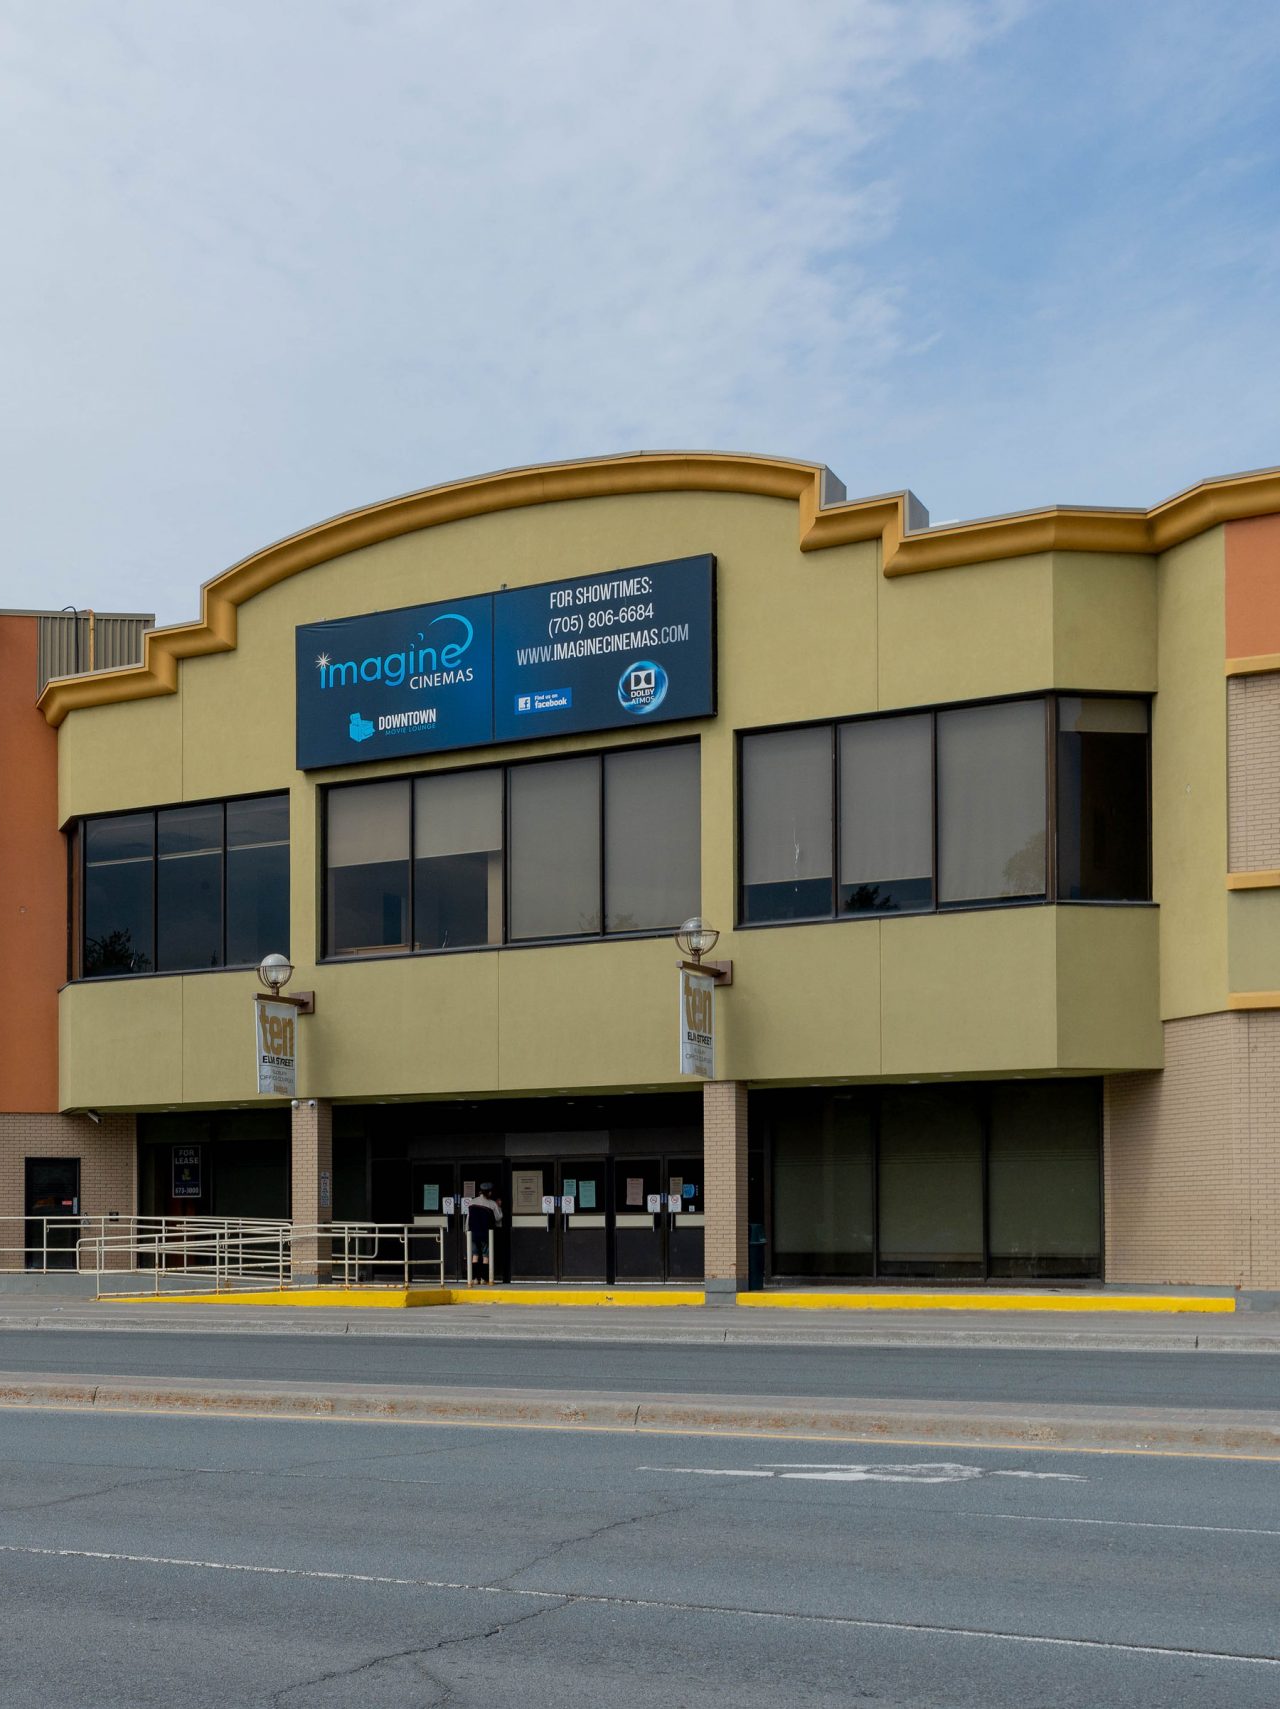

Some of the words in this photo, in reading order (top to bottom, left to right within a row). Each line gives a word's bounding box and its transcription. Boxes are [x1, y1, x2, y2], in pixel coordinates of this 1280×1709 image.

[550, 590, 573, 609] FOR
[576, 576, 653, 605] SHOWTIMES:
[548, 614, 584, 638] (705)
[588, 603, 654, 628] 806-6684
[517, 623, 689, 666] WWW.IMAGINECINEMAS.COM
[409, 668, 474, 690] CINEMAS
[534, 697, 567, 709] facebook
[631, 688, 655, 698] DOLBY
[631, 696, 655, 705] ATMOS
[378, 708, 437, 731] DOWNTOWN
[409, 723, 436, 733] LOUNGE
[259, 1004, 294, 1058] ten
[276, 1057, 293, 1067] STREET
